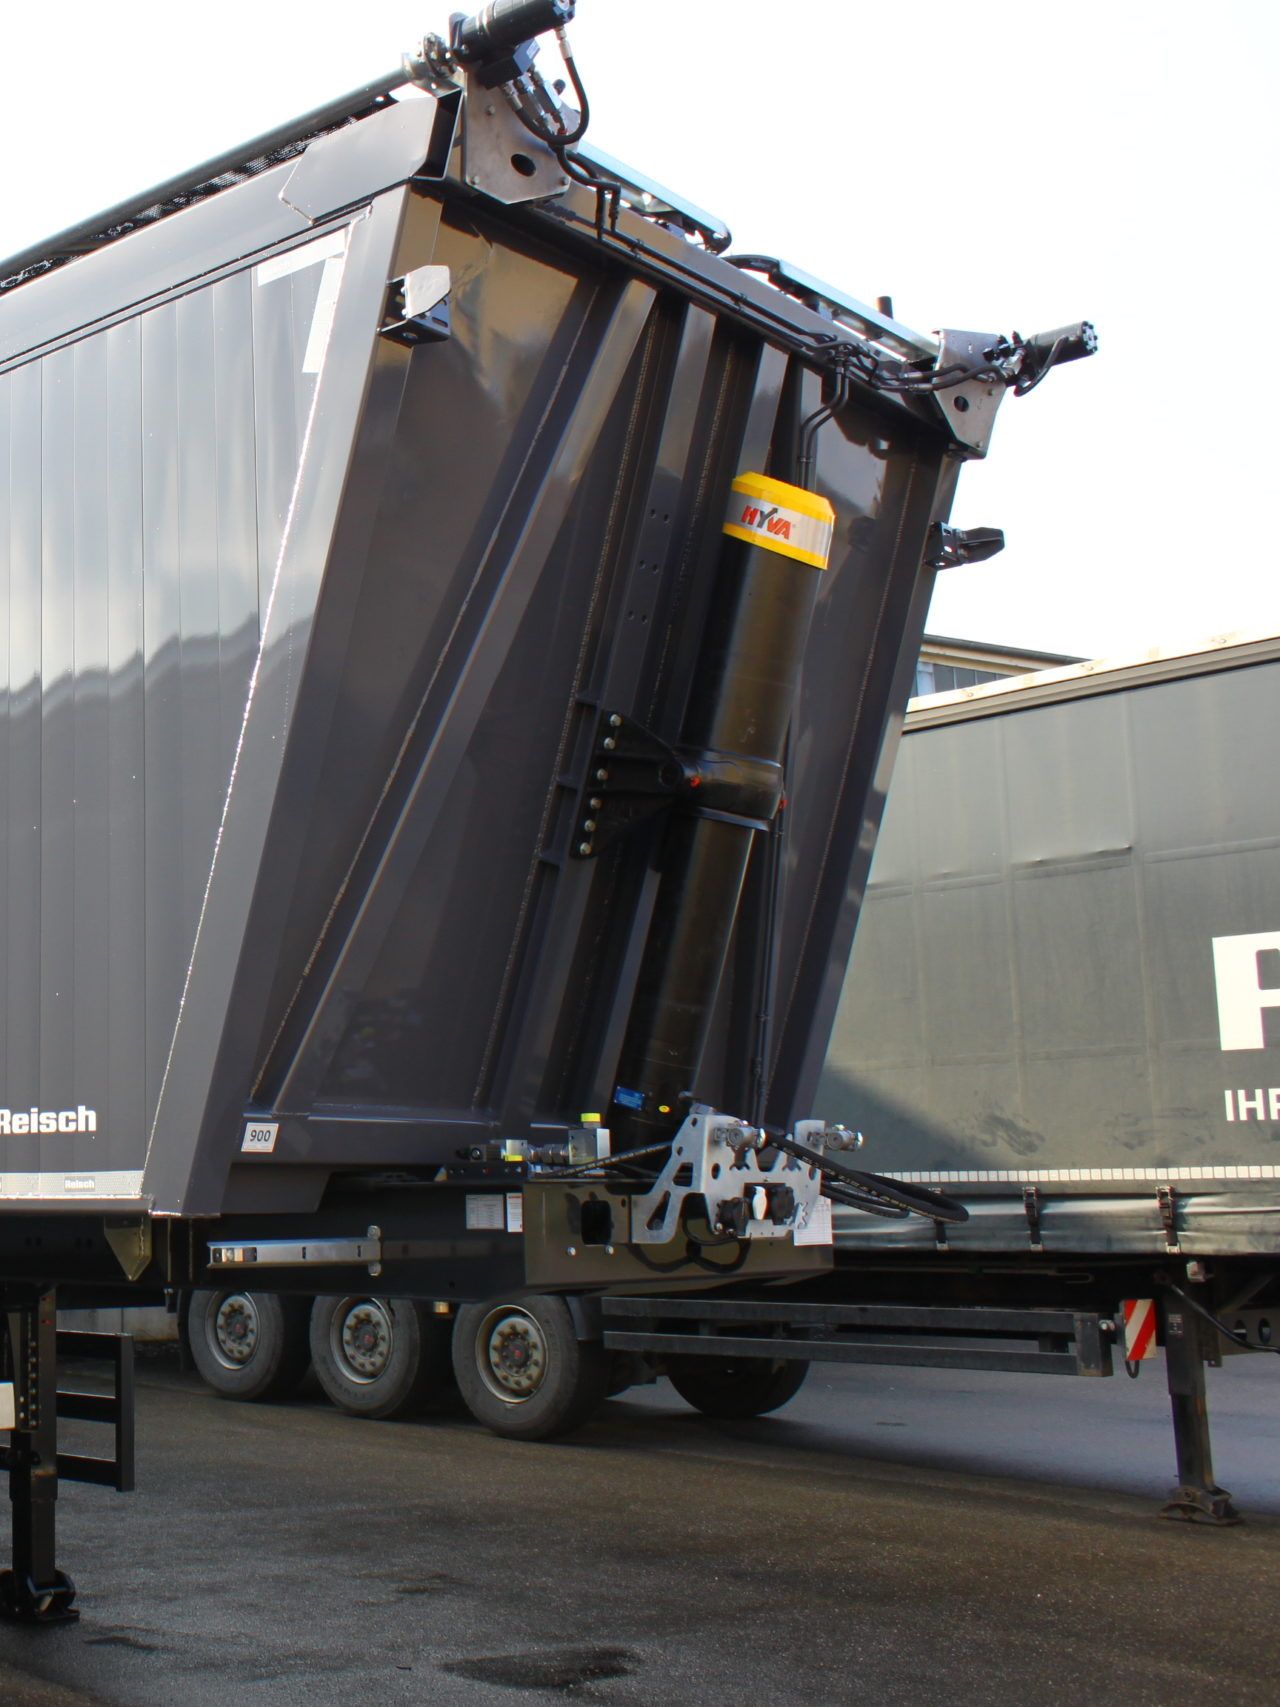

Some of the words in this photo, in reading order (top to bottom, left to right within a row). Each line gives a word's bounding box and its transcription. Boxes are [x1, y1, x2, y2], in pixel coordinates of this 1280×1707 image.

[741, 505, 791, 540] HYVA
[249, 1129, 271, 1142] 900
[64, 1179, 95, 1190] Reisch
